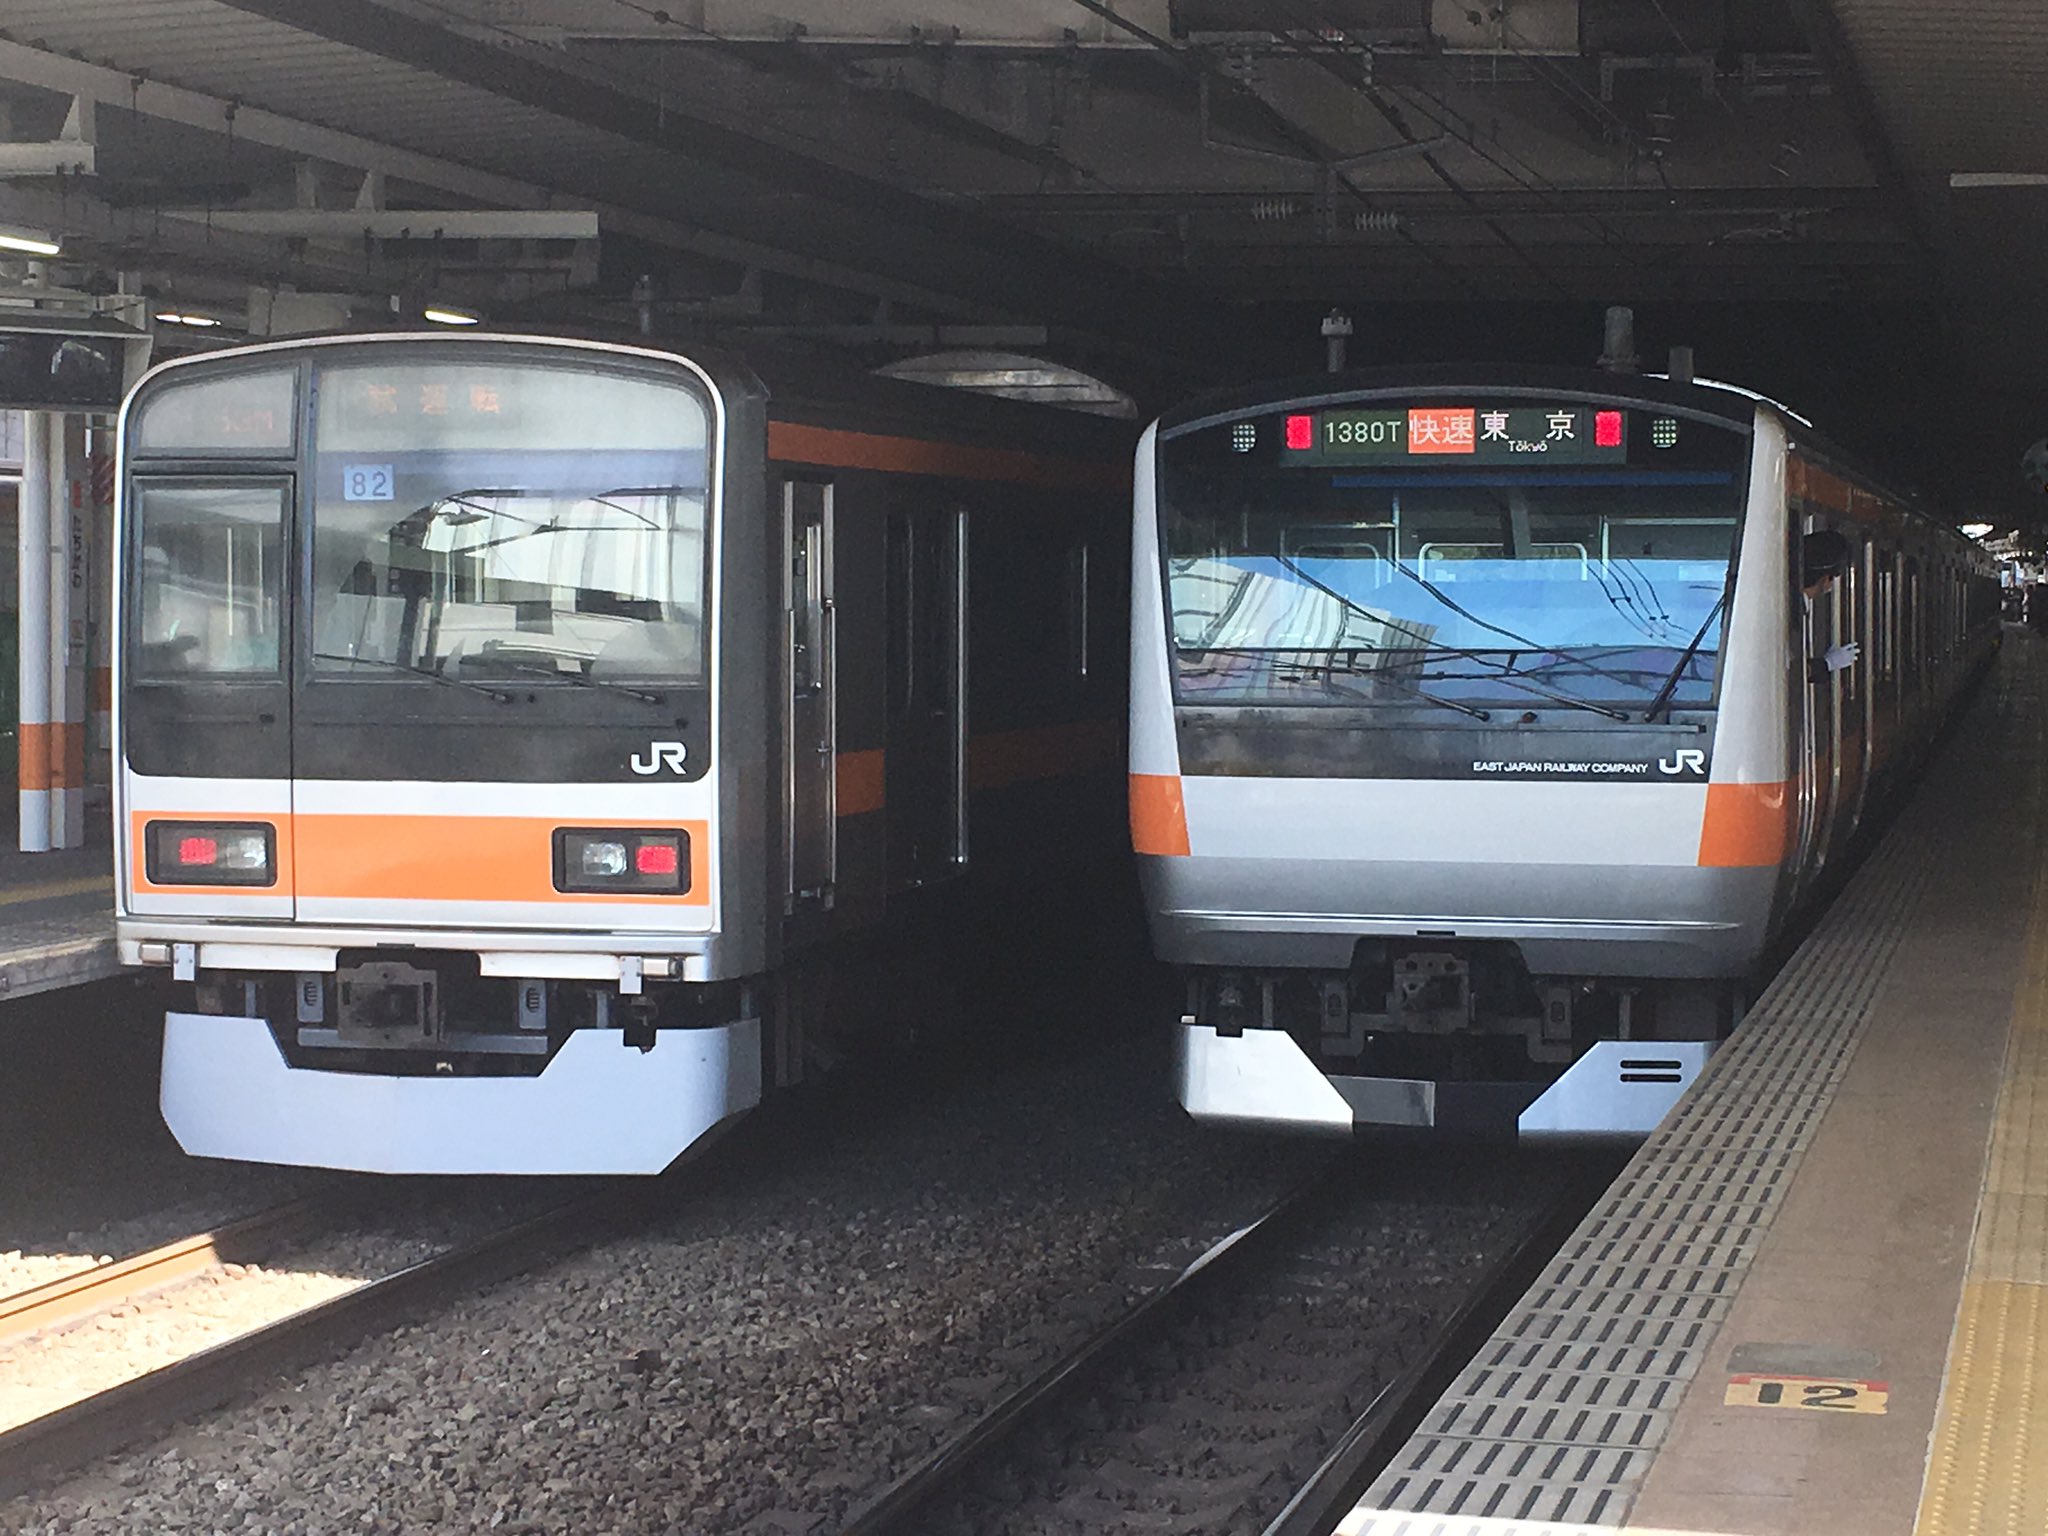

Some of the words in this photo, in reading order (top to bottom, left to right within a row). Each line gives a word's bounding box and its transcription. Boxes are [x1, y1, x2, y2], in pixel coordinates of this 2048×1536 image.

[1325, 421, 1401, 443] 1380T
[1409, 414, 1474, 445] 快速
[352, 471, 387, 497] 82
[631, 742, 687, 774] JR
[1473, 762, 1504, 772] EAST
[1504, 762, 1542, 772] JAPAN
[1543, 763, 1590, 773] RAILWAY
[1591, 763, 1648, 773] COMPANY
[1658, 749, 1705, 775] JR
